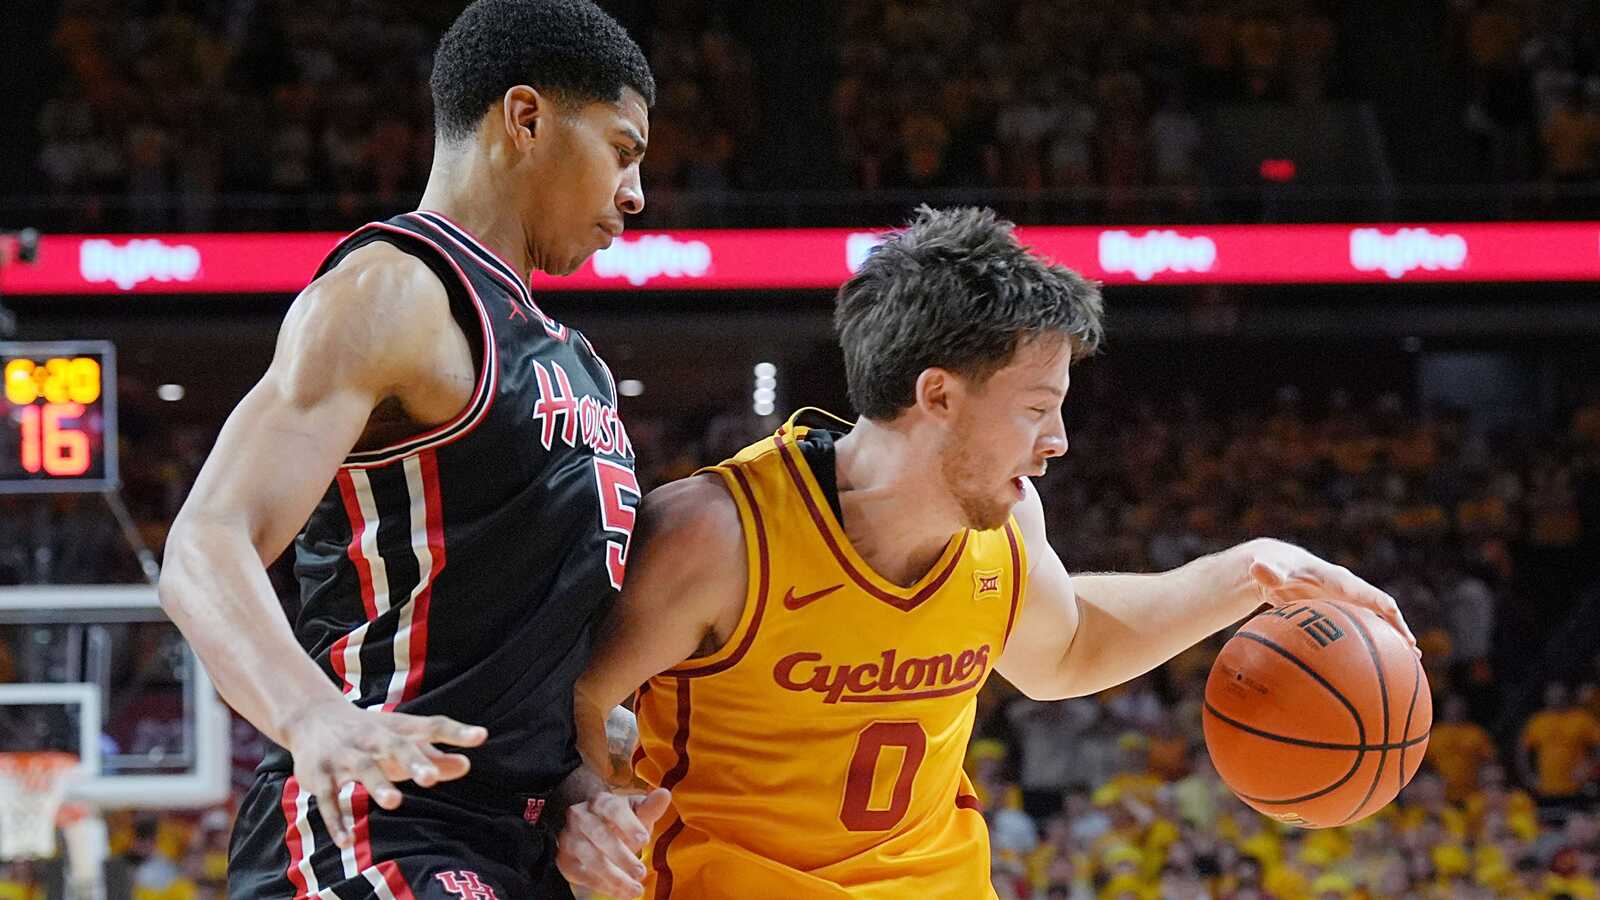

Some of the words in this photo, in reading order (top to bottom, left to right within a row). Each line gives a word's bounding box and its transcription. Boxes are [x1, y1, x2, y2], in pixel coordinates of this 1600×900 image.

[21, 403, 90, 476] 16
[593, 455, 642, 592] 5
[773, 644, 991, 704] Cyclones
[838, 720, 928, 832] 0
